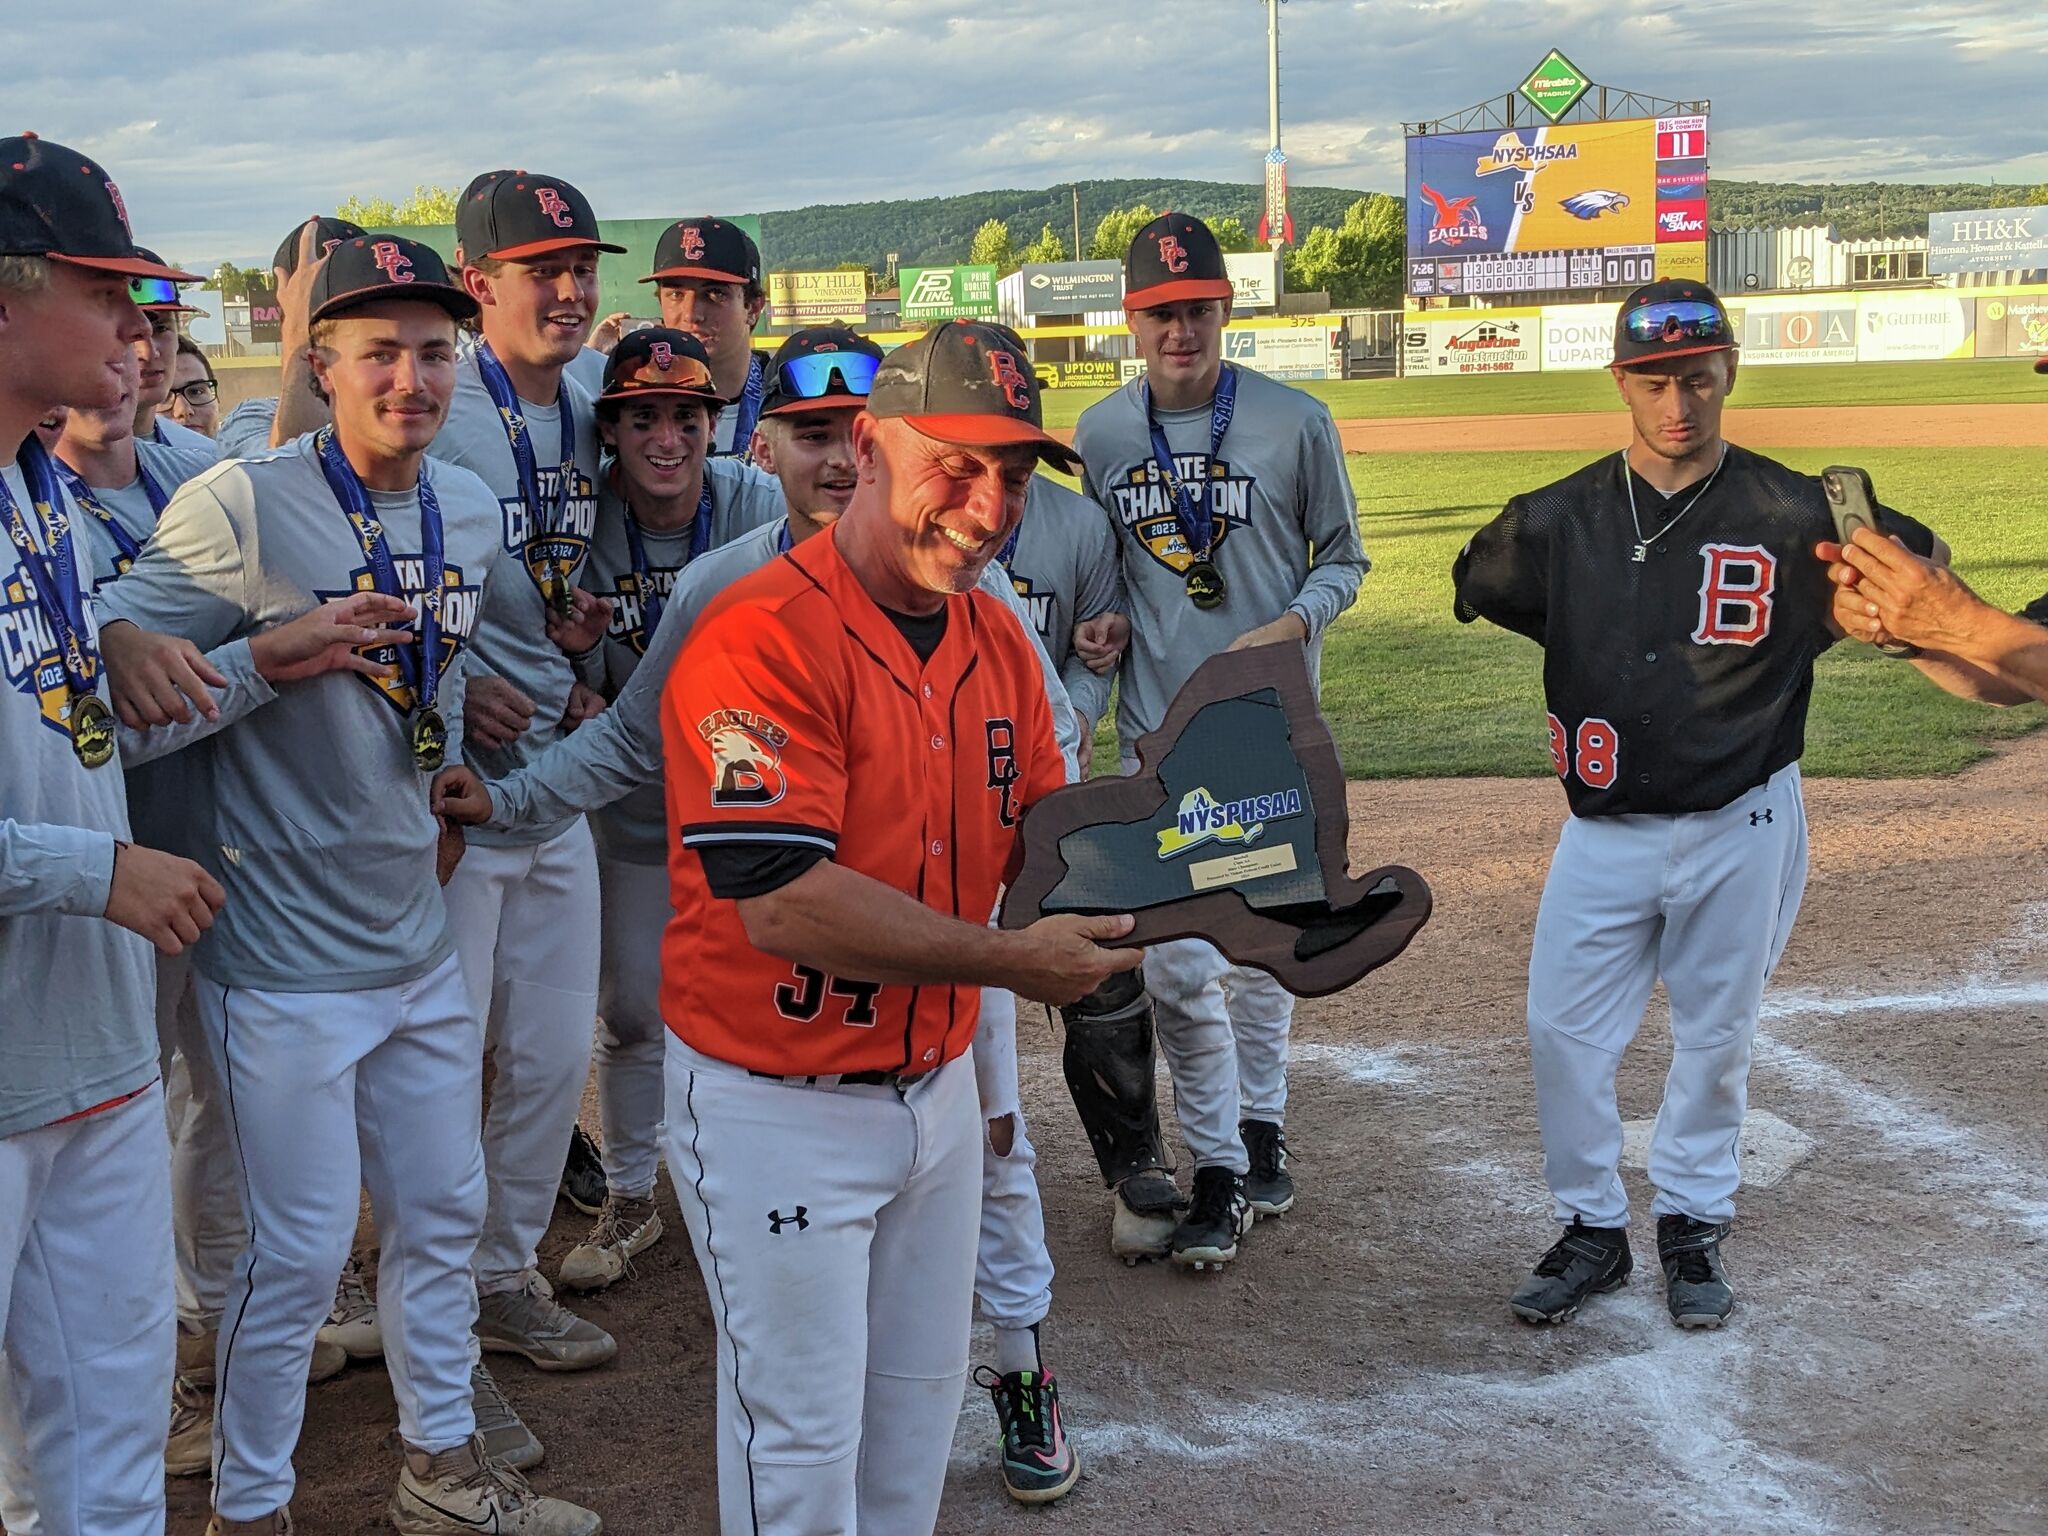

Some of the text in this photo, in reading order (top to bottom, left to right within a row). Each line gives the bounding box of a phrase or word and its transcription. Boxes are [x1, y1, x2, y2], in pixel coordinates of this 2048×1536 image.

[1672, 132, 1690, 157] 11
[1492, 143, 1578, 164] NYSPHSAA
[1659, 211, 1687, 223] NBT
[1428, 225, 1489, 245] EAGLES
[1951, 217, 2033, 242] HH&K
[1931, 245, 1968, 256] Hinman,
[1970, 241, 2003, 253] Howard
[2005, 240, 2013, 251] &
[2014, 239, 2043, 250] Kattell
[1411, 263, 1434, 275] 7:26
[1606, 258, 1653, 282] 0 0 0
[1788, 261, 1811, 279] 42
[773, 274, 862, 290] BULLY HILL
[1051, 273, 1114, 285] WILMINGTON
[1239, 277, 1262, 289] Tier
[814, 288, 862, 297] VINEYARDS
[963, 281, 991, 292] QUALITY
[1052, 284, 1074, 292] TRUST
[970, 290, 991, 300] METAL
[773, 305, 863, 315] WINE WITH LAUGHTER!
[940, 306, 978, 316] PRECISION
[980, 305, 993, 314] INC
[1290, 318, 1316, 328] 375
[1887, 311, 1951, 327] GUTHRIE
[1444, 335, 1521, 352] Augustine
[1450, 348, 1528, 363] Construction
[1745, 352, 1783, 360] INSURANCE
[1064, 362, 1114, 374] UPTOWN
[1288, 370, 1312, 378] Street
[1059, 380, 1122, 388] UPTOWNLIMO.com
[1691, 541, 1778, 648] B
[697, 707, 790, 748] EAGLES
[1179, 788, 1302, 836] NYSPHSAA
